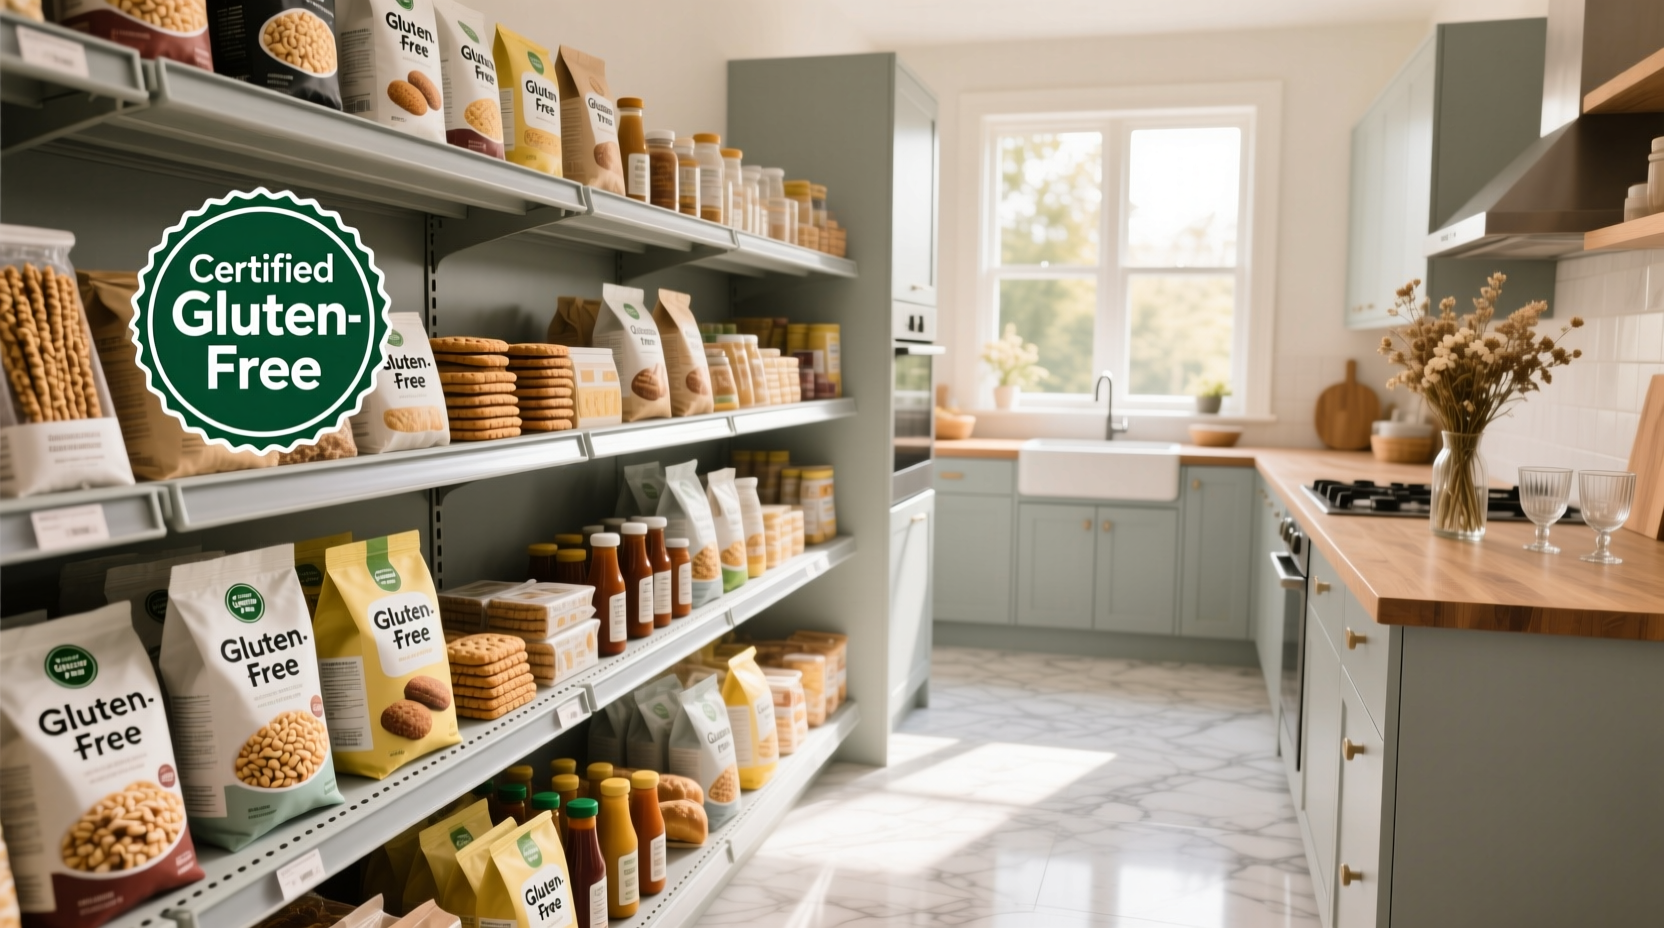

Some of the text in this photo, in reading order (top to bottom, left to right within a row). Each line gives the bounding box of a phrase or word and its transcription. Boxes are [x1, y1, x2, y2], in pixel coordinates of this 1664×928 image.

[394, 372, 426, 390] Free
[393, 626, 431, 650] Free
[247, 658, 300, 688] Free
[73, 724, 142, 761] Free
